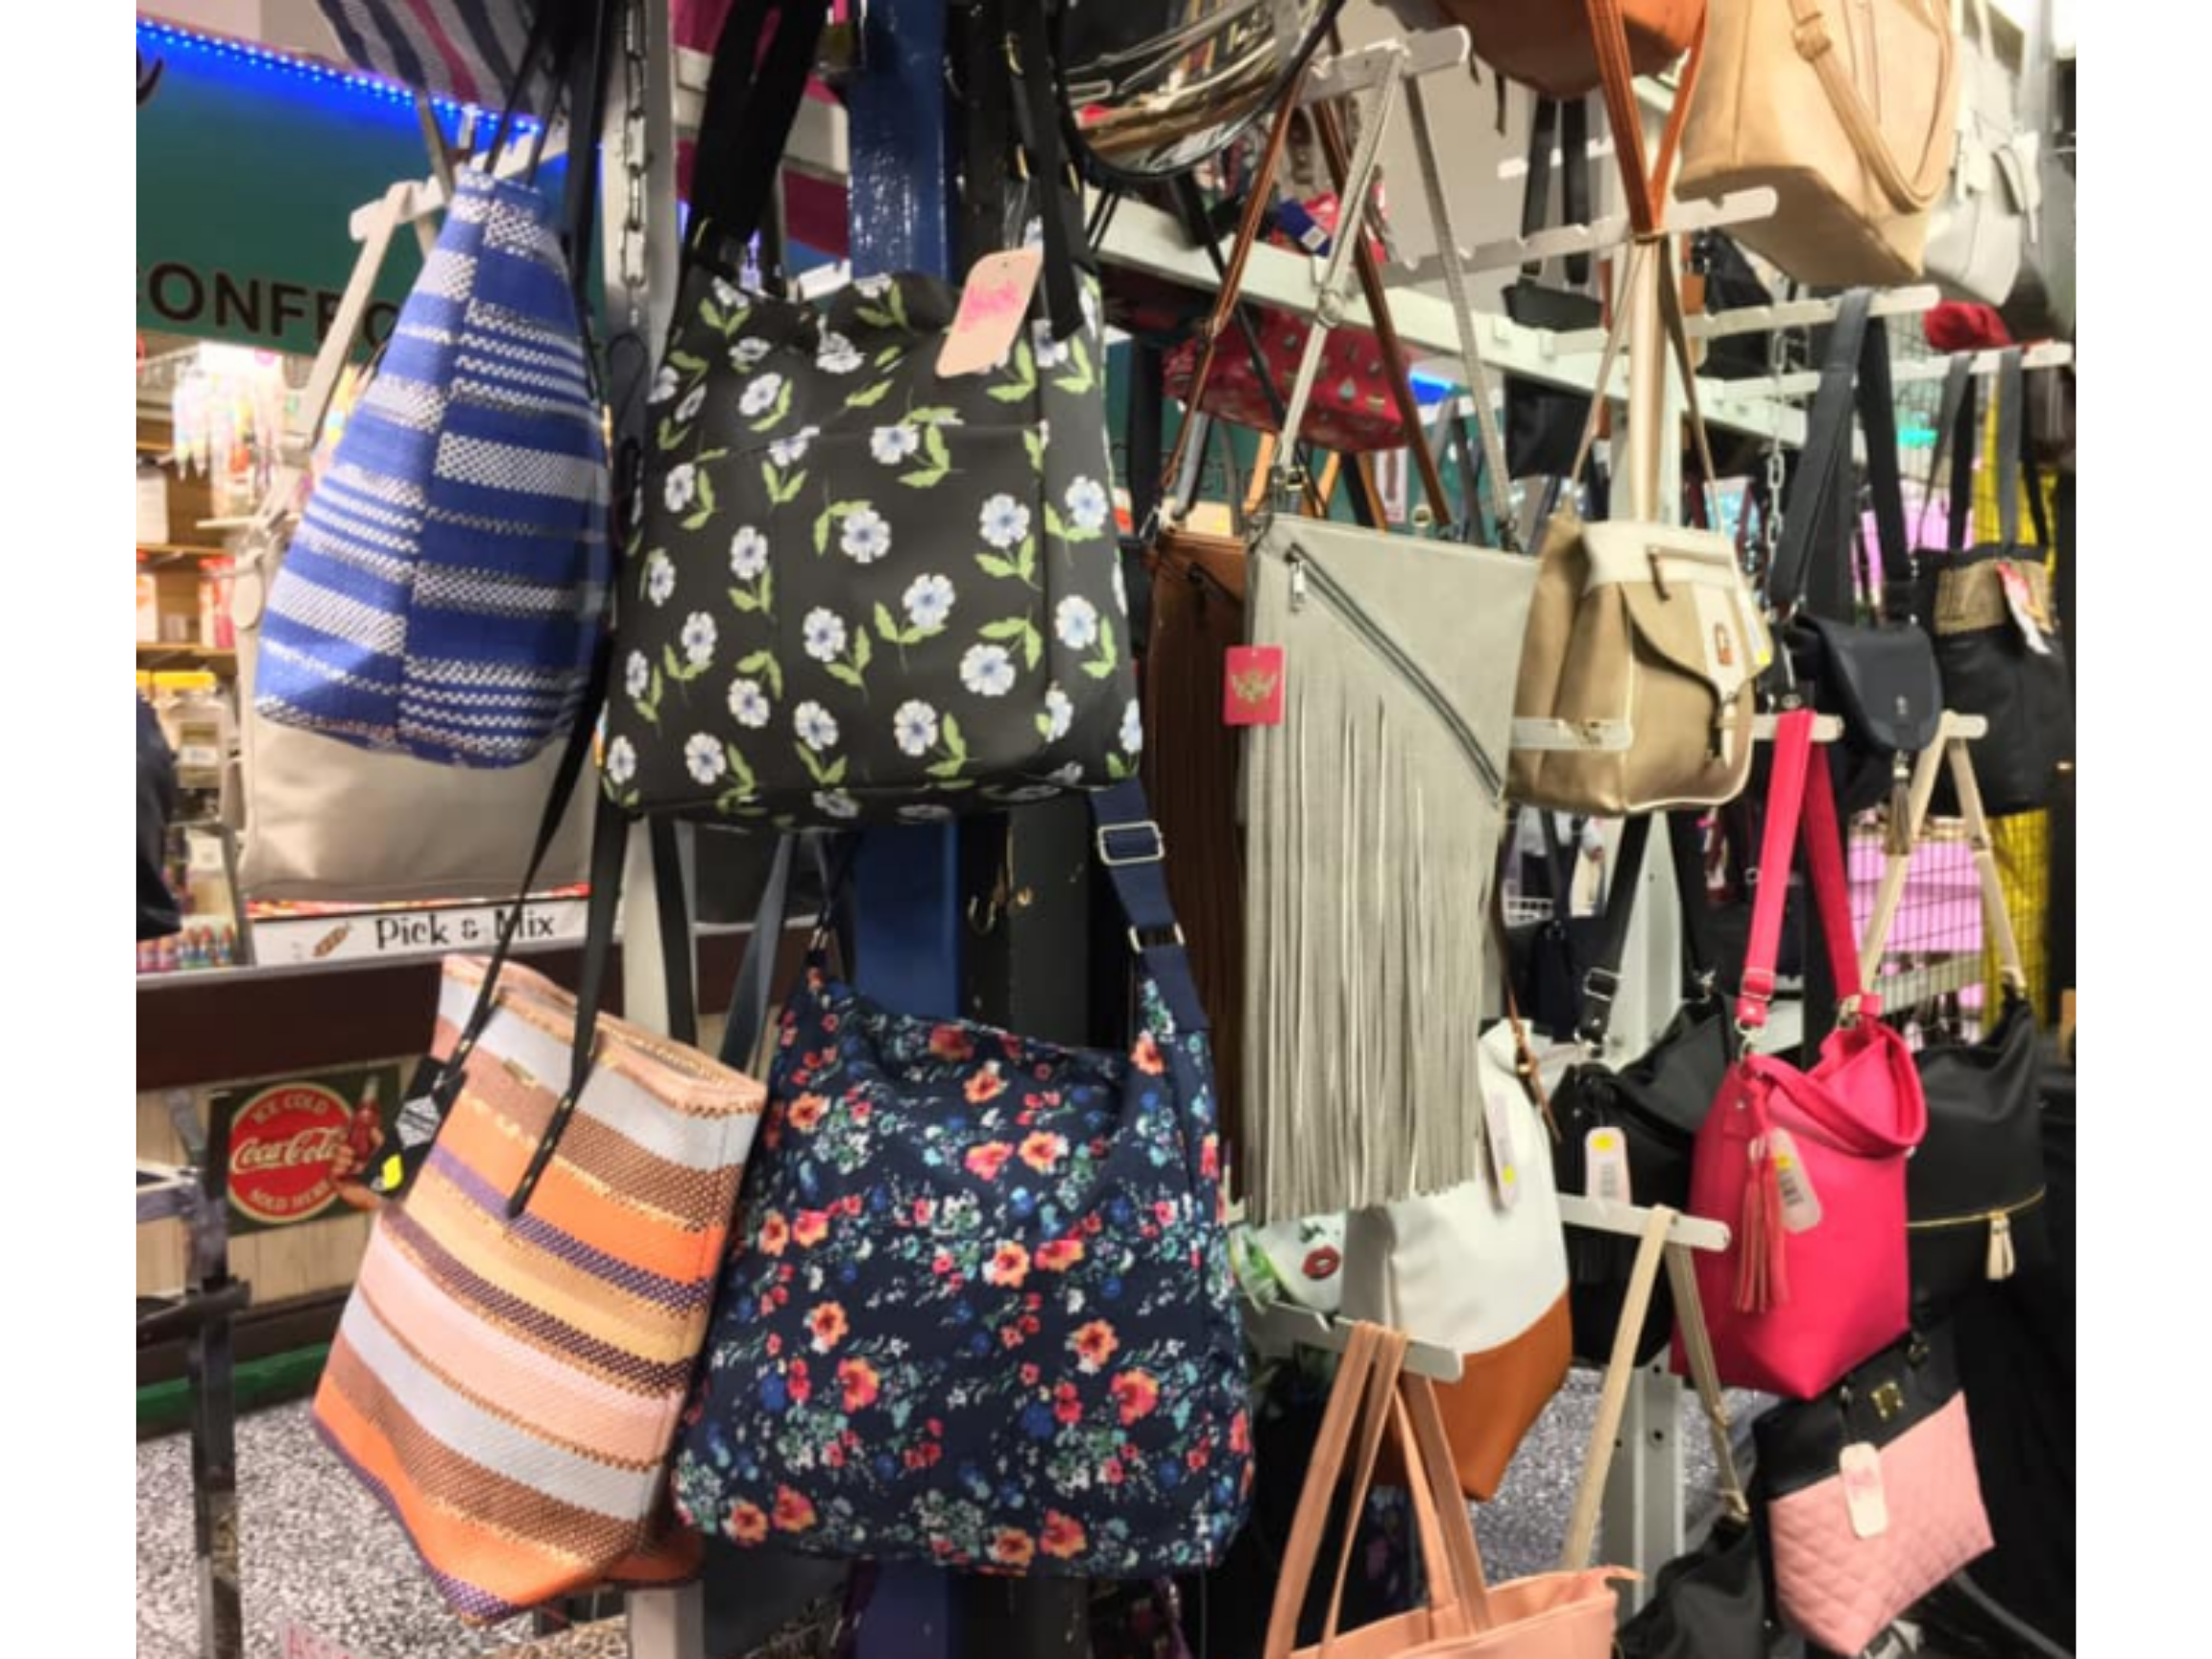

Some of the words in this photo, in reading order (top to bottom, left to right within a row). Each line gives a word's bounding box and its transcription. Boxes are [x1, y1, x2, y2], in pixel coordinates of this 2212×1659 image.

[376, 914, 449, 950] Pick
[462, 919, 478, 941] &
[494, 909, 554, 941] Mix
[284, 1094, 328, 1115] COLD
